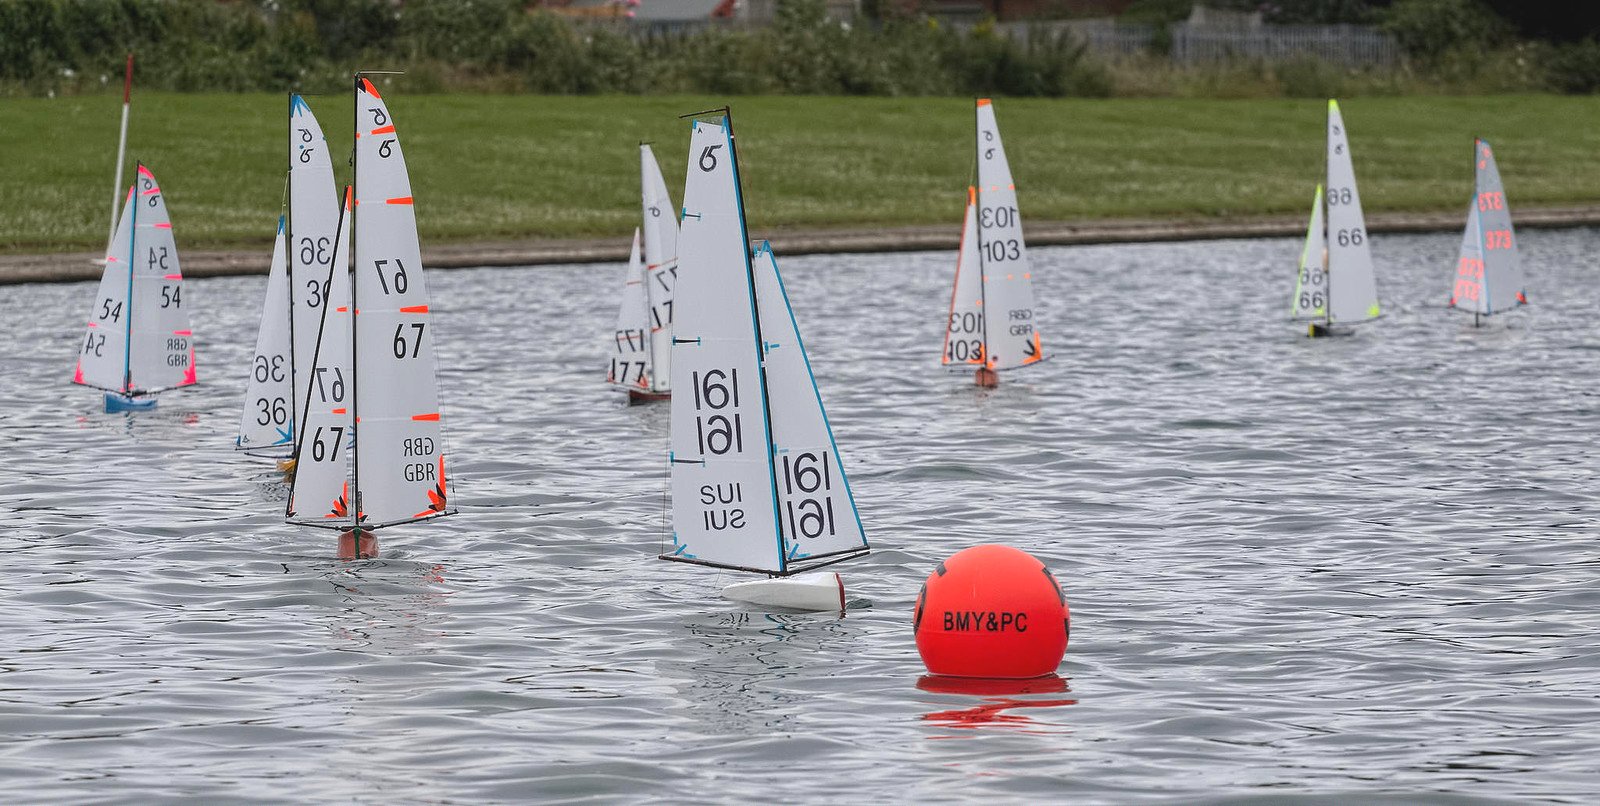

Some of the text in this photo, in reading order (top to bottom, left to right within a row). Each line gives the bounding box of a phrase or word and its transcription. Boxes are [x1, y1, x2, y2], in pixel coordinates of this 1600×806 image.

[1338, 228, 1363, 247] 66
[1486, 229, 1512, 250] 373
[983, 239, 1020, 262] 103
[161, 286, 181, 308] 54
[1300, 291, 1323, 309] 66
[100, 299, 122, 323] 54
[393, 323, 425, 359] 67
[1009, 324, 1033, 336] GBR
[167, 354, 187, 367] GBR
[948, 340, 982, 361] 103
[612, 358, 646, 383] 177
[693, 368, 739, 411] 161
[257, 397, 286, 426] 36
[312, 427, 344, 462] 67
[404, 464, 435, 482] GBR
[783, 451, 831, 495] 161
[700, 482, 742, 505] SUI
[944, 611, 1028, 633] BMY&PC
